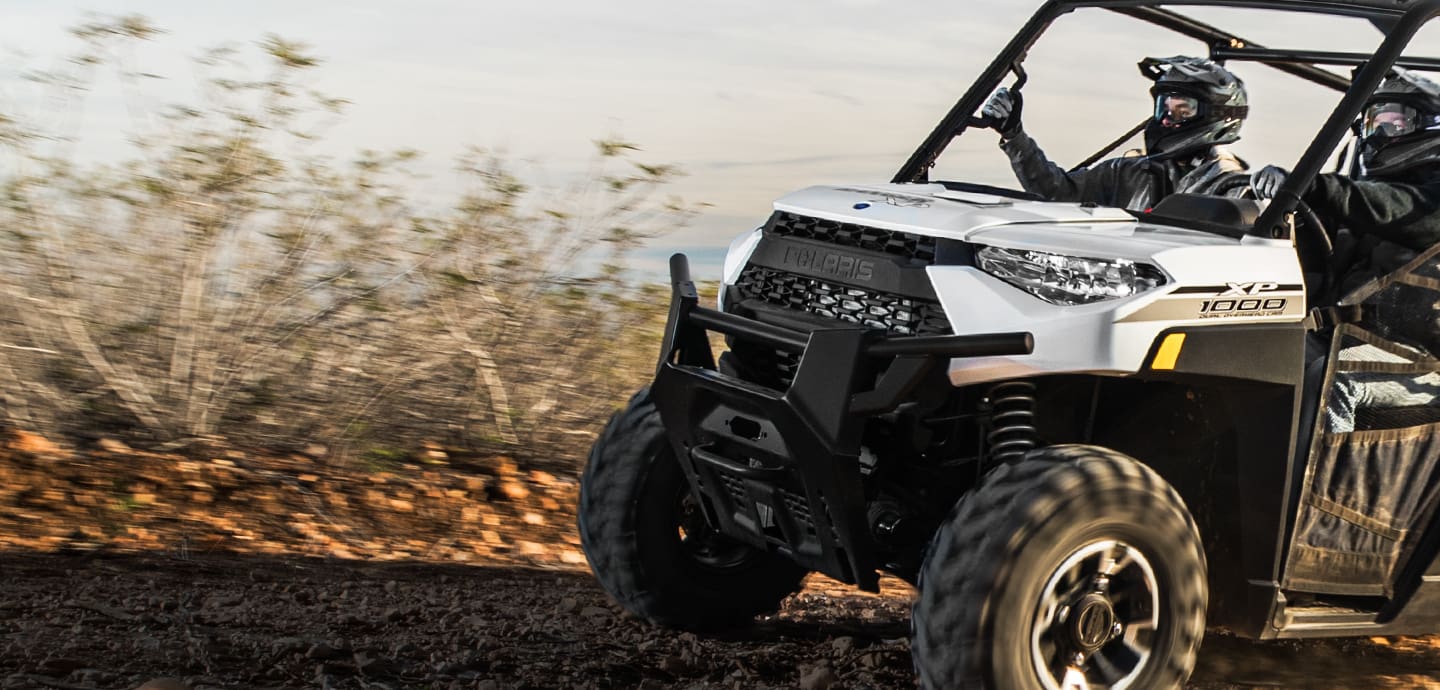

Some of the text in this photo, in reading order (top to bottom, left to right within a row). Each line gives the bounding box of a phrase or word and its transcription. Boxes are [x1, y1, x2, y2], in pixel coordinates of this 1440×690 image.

[784, 246, 874, 280] POLARIS
[1218, 282, 1279, 297] XP
[1199, 298, 1288, 313] 1000
